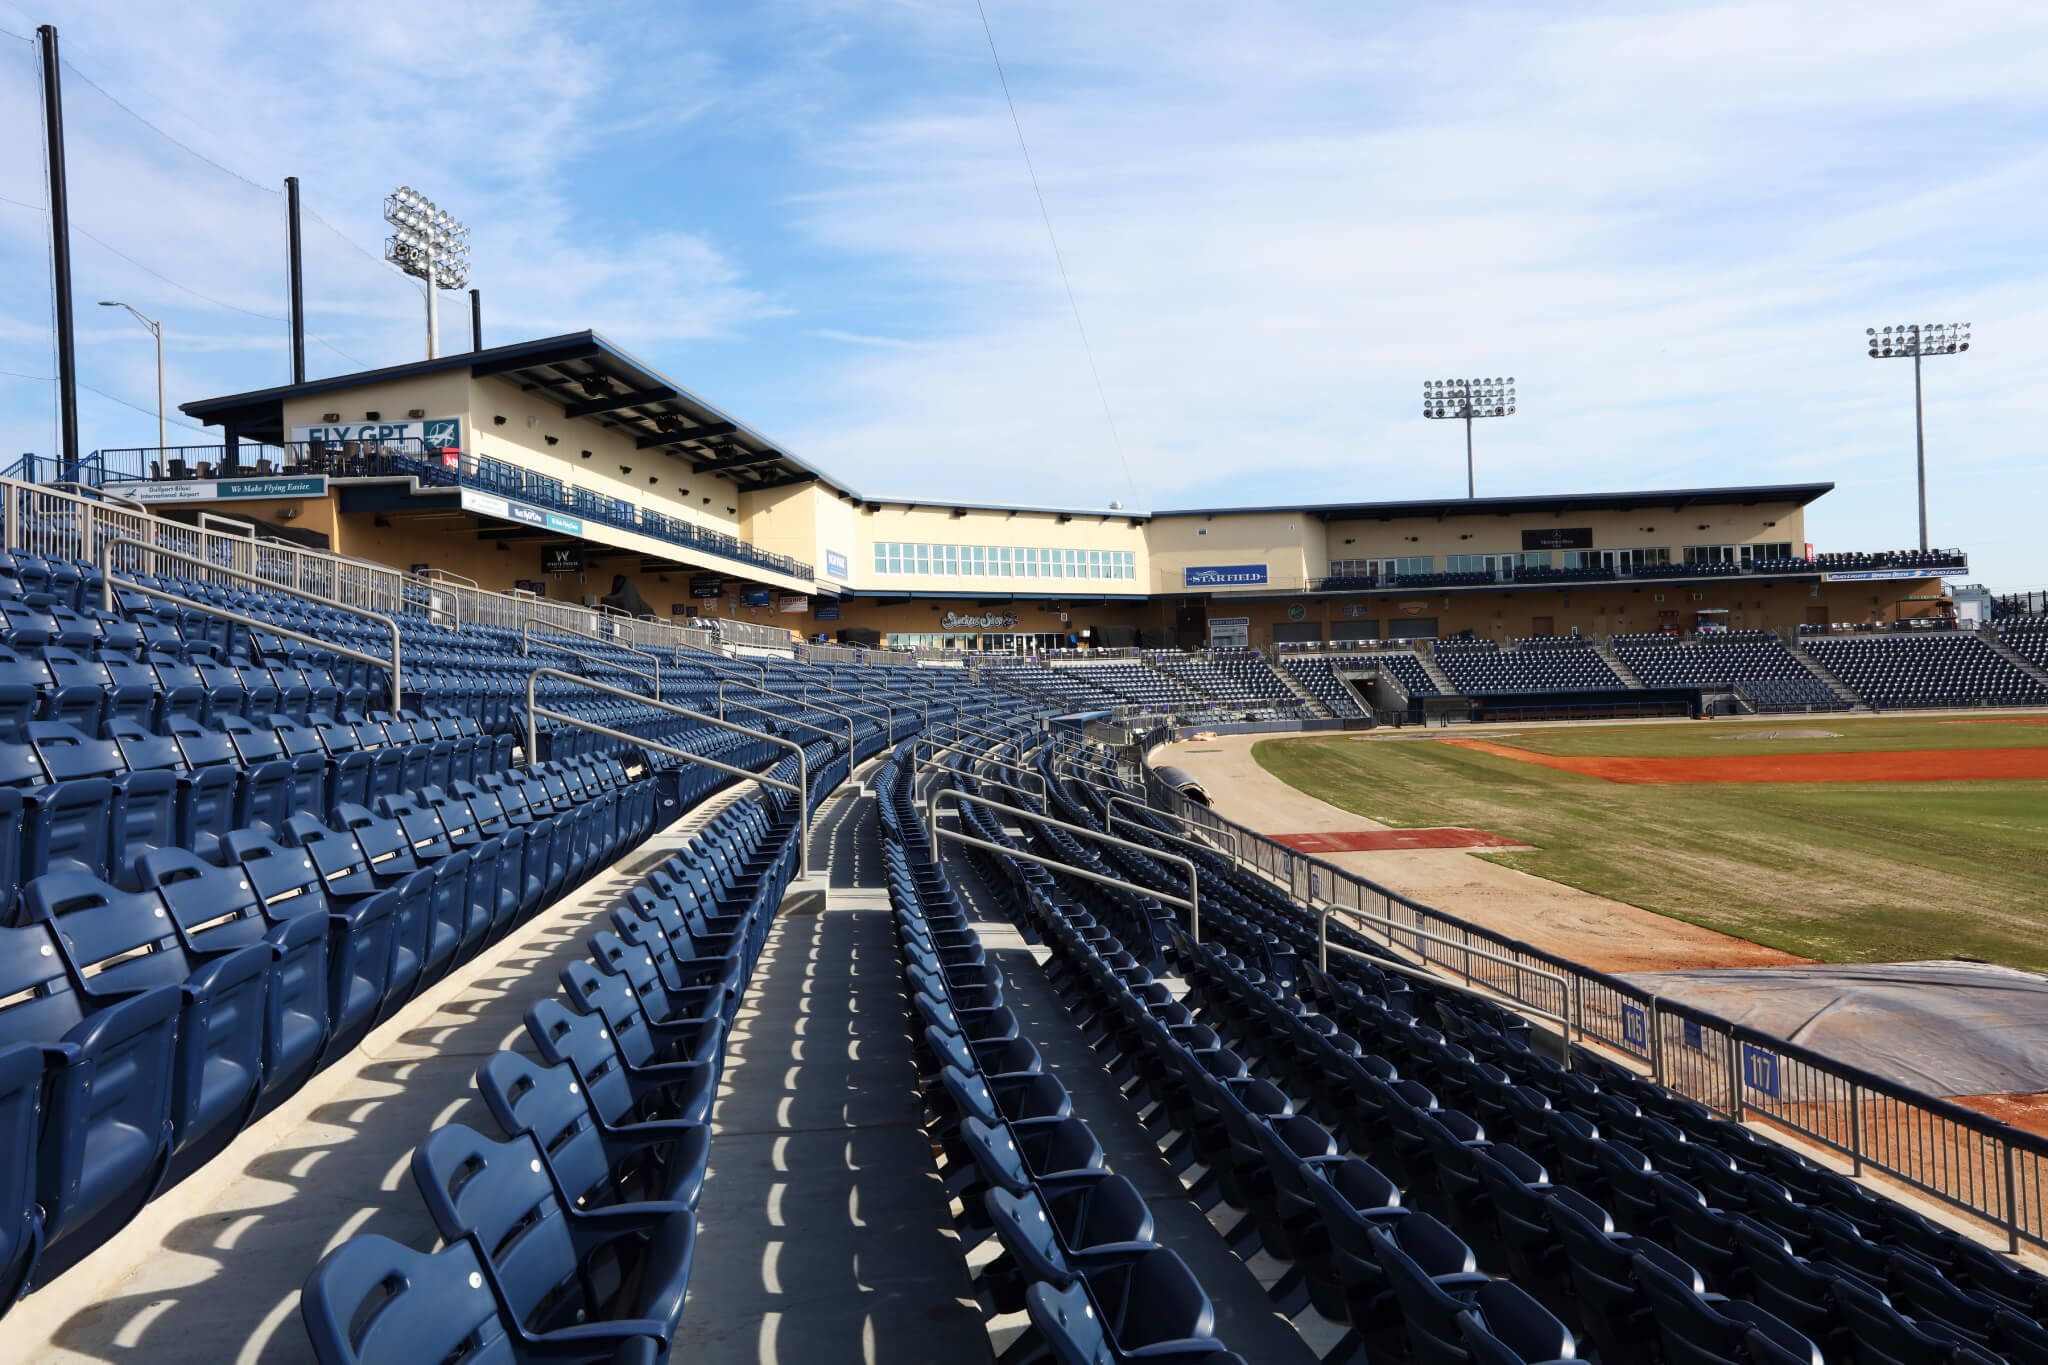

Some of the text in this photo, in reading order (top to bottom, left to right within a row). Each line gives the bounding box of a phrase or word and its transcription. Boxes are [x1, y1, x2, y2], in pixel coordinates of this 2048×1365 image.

[309, 424, 409, 447] FLY GPT
[231, 485, 241, 493] We
[243, 484, 263, 493] Make
[264, 484, 286, 494] Flying
[1626, 1011, 1642, 1042] 115
[1751, 1053, 1770, 1090] 117
